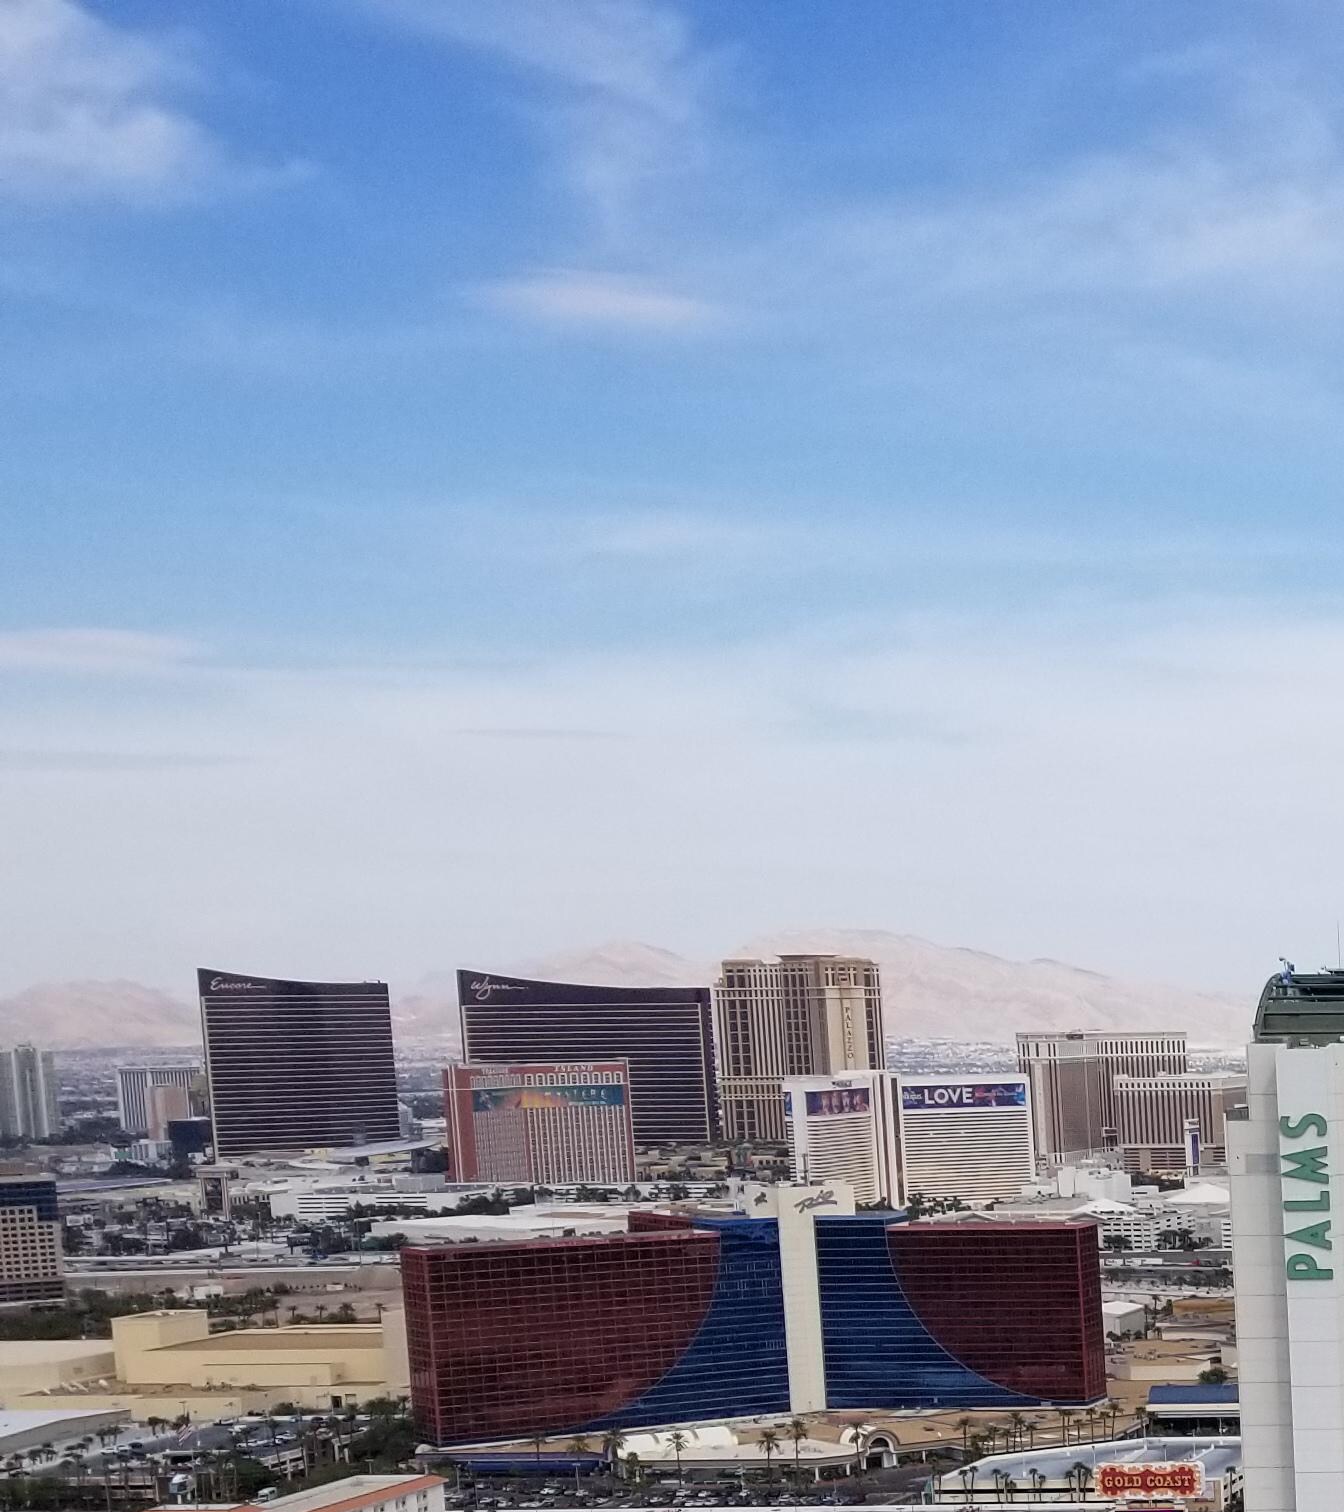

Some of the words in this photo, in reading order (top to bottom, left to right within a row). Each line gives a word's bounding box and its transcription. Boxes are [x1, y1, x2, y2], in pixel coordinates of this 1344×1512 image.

[210, 976, 266, 991] Encore
[470, 976, 527, 1000] Wynn
[844, 1006, 854, 1059] PALAZZO
[553, 1064, 594, 1072] ISLAND
[922, 1087, 974, 1105] LOVE
[1279, 1112, 1334, 1281] PALMS
[1104, 1476, 1141, 1488] GOLD
[1146, 1475, 1192, 1487] COAST
